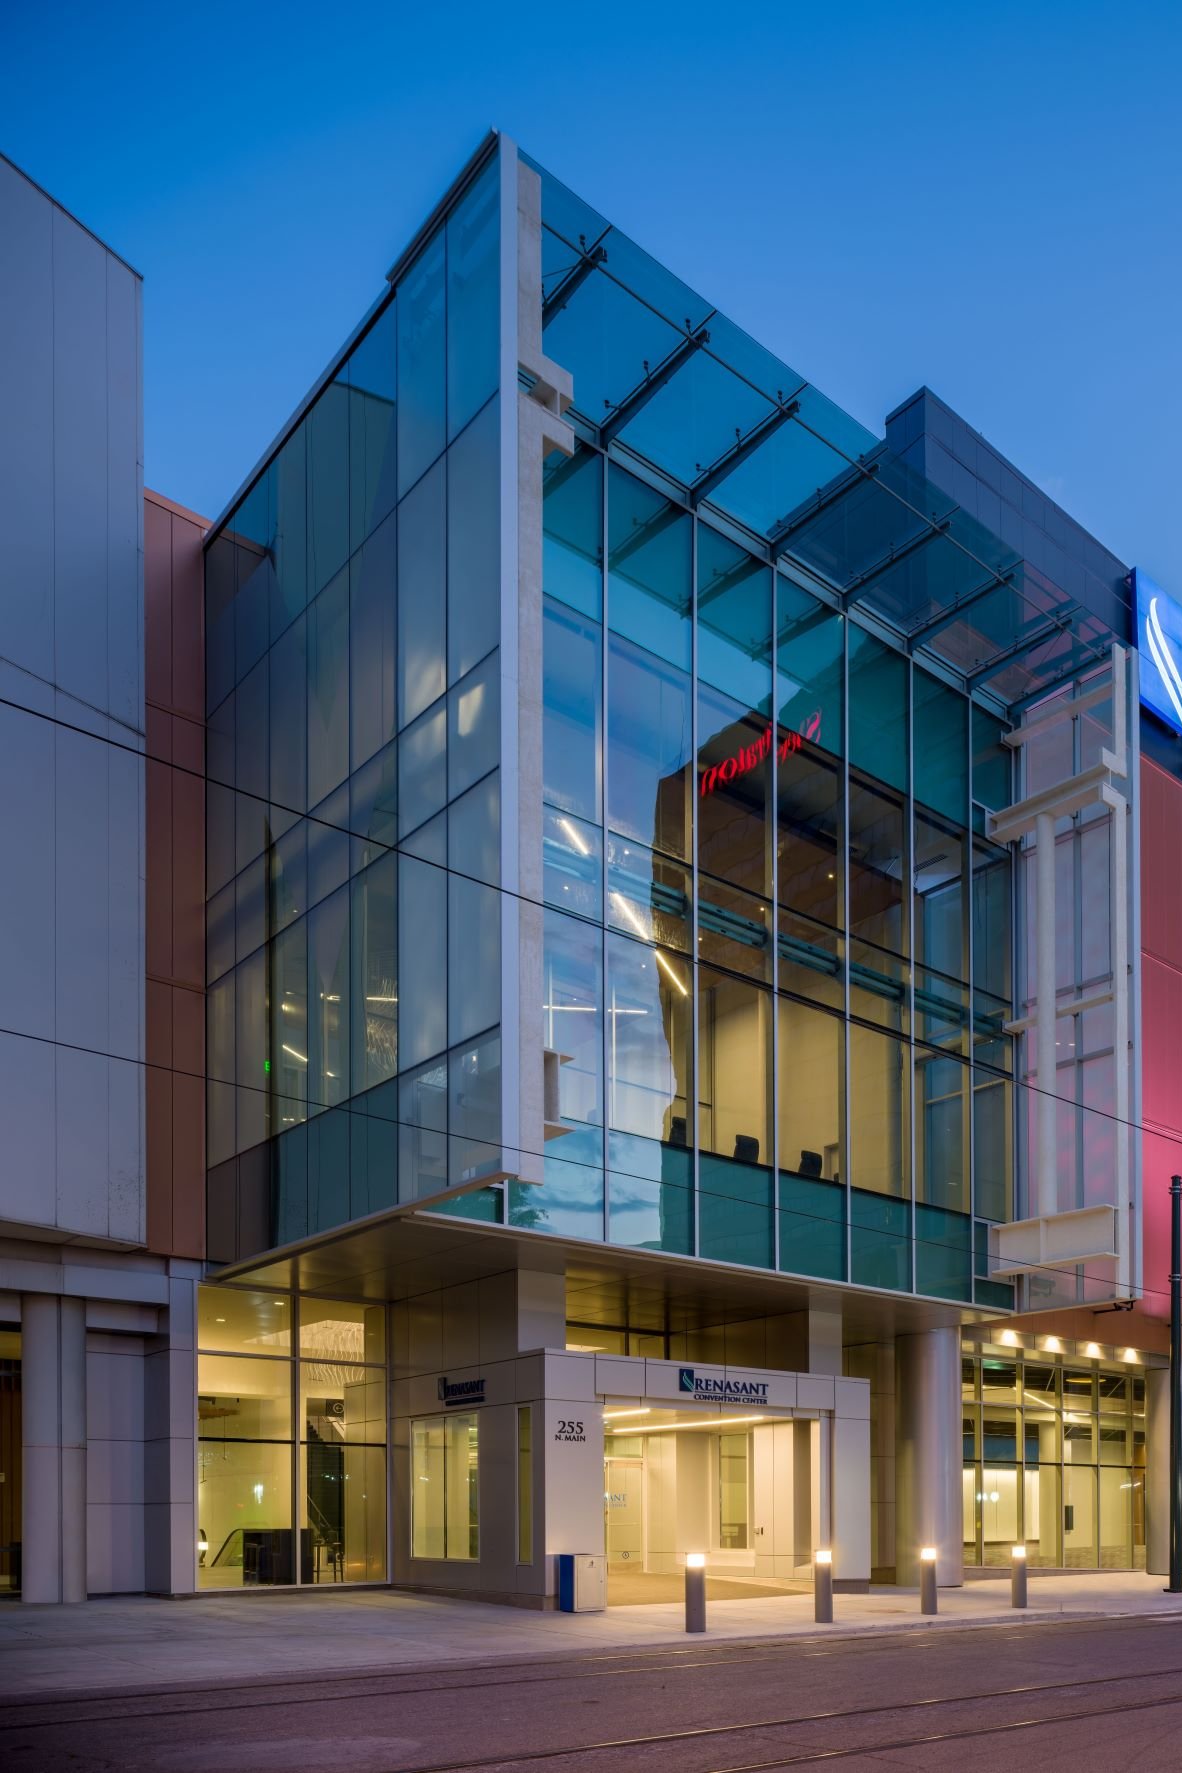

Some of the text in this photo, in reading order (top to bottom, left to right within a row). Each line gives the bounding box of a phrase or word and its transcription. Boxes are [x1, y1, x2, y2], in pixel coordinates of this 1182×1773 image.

[695, 1378, 769, 1396] RENASANT
[693, 1393, 741, 1403] CONVENTION
[558, 1420, 584, 1434] 255
[564, 1434, 586, 1442] MAIN
